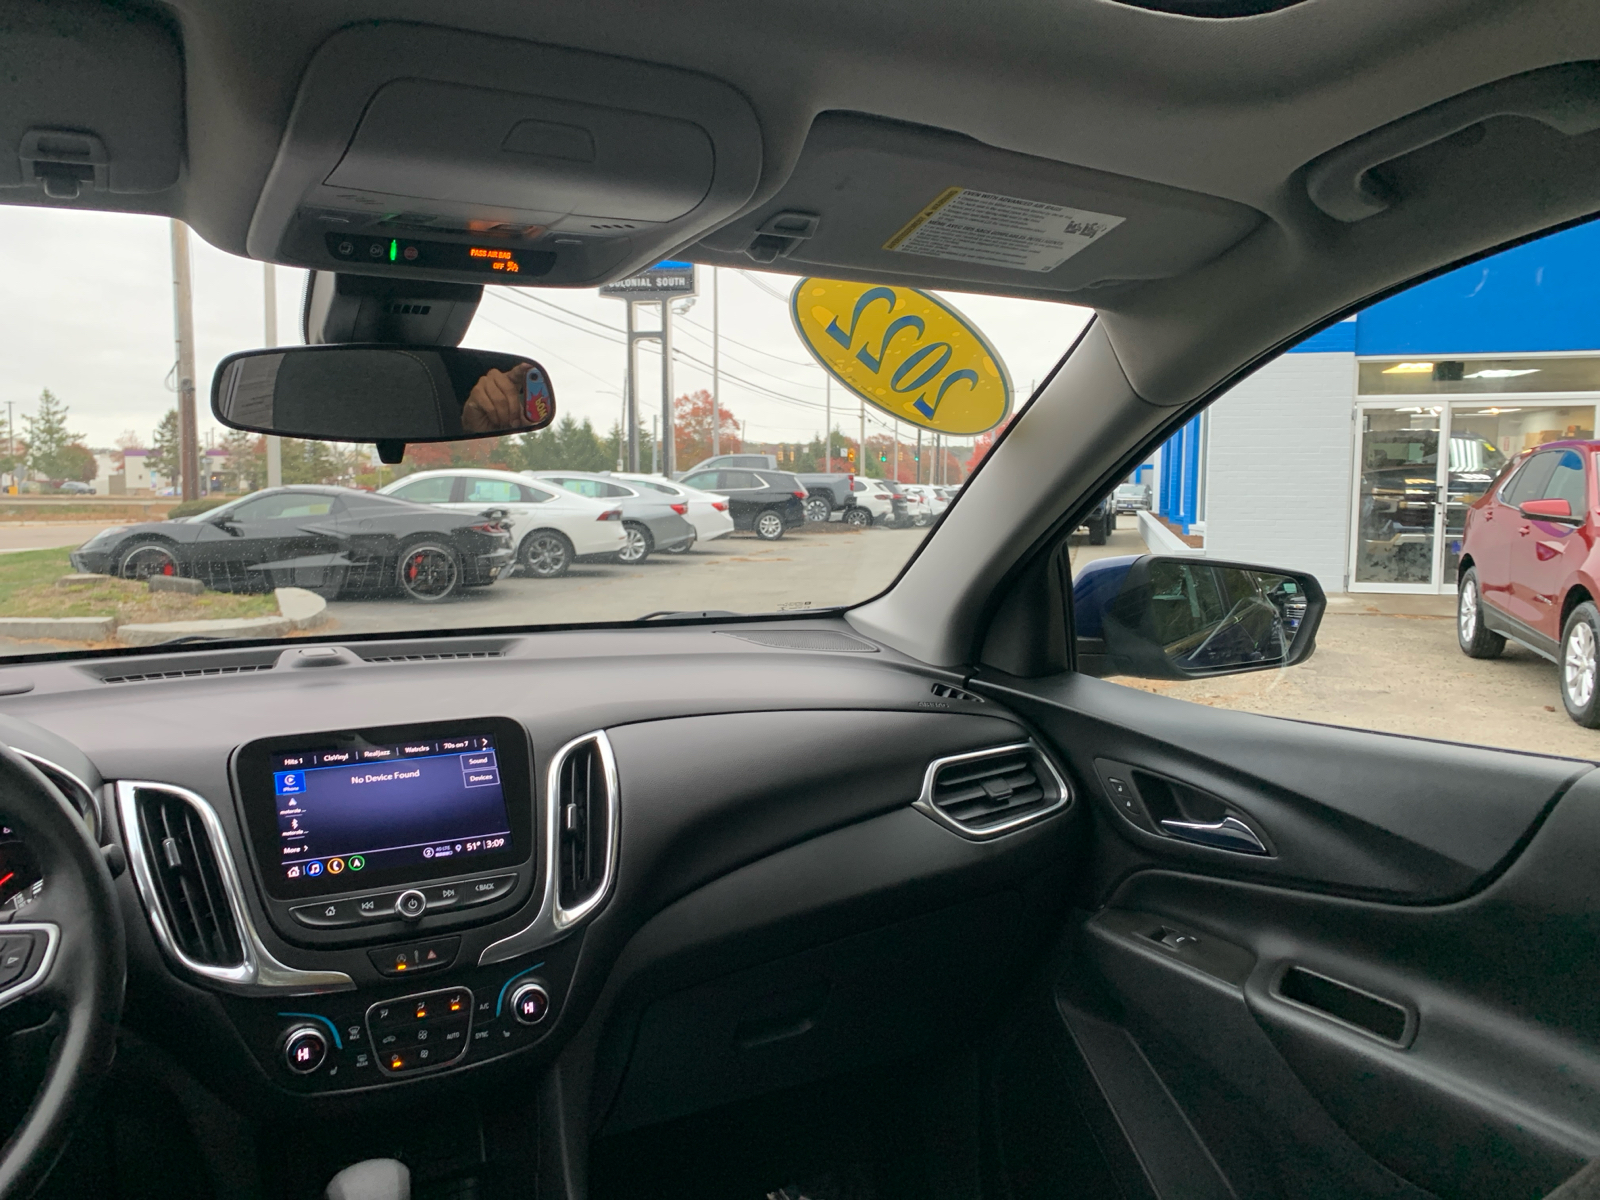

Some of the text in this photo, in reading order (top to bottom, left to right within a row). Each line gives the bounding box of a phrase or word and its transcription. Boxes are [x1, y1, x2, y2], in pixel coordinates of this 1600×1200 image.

[470, 247, 512, 260] PASS AIR BAG
[493, 261, 505, 270] OFF
[656, 277, 685, 287] SOUTH
[284, 758, 298, 766] Hits
[469, 756, 488, 765] Sound
[351, 769, 420, 784] No Device Found
[470, 774, 493, 782] Devices
[466, 841, 481, 852] 51°
[486, 838, 505, 849] 3:09
[283, 847, 301, 855] More
[479, 883, 495, 891] BACK
[524, 1001, 534, 1015] HI
[446, 1031, 460, 1040] AUTO
[475, 1030, 489, 1039] SYNC
[297, 1047, 310, 1062] HI
